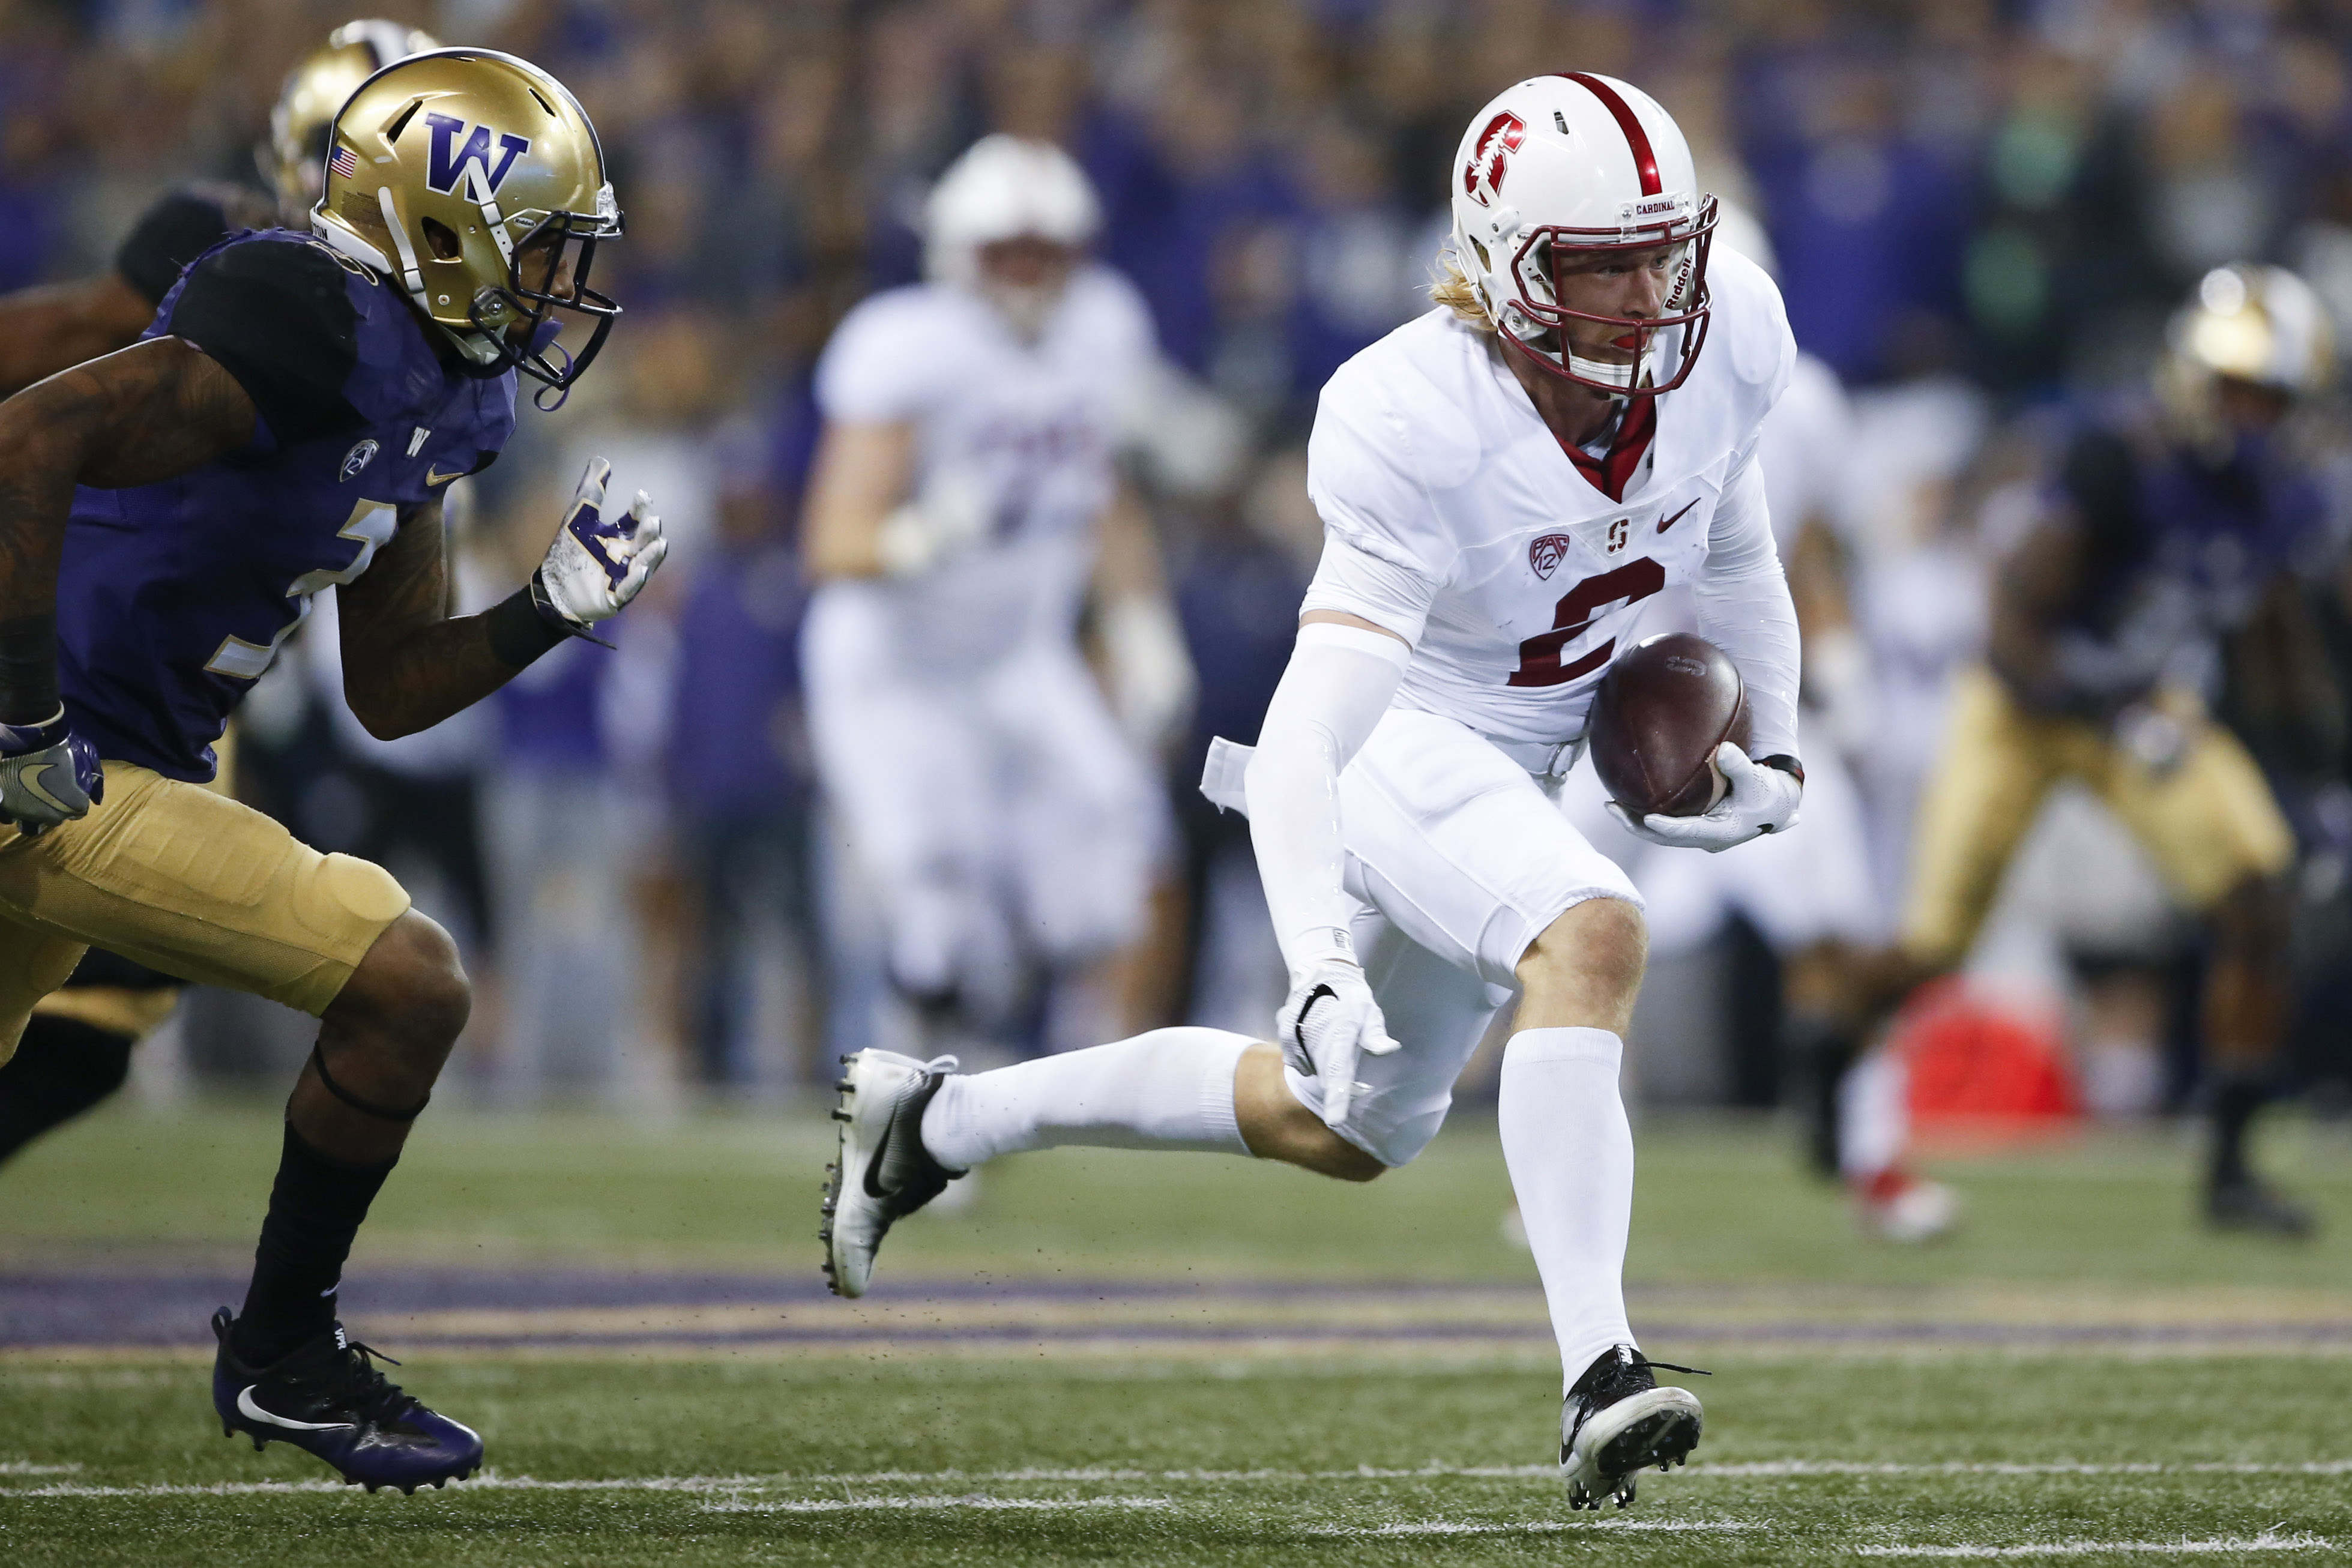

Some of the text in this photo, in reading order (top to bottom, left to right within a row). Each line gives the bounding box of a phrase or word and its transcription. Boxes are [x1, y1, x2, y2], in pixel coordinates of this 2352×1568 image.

[423, 111, 531, 205] W
[1636, 200, 1675, 215] CARDINAL
[1665, 257, 1692, 310] Riddell
[406, 426, 431, 457] W
[1531, 535, 1568, 564] PAC
[1537, 553, 1557, 571] 12
[1506, 556, 1665, 687] 2
[334, 1327, 347, 1350] VPR
